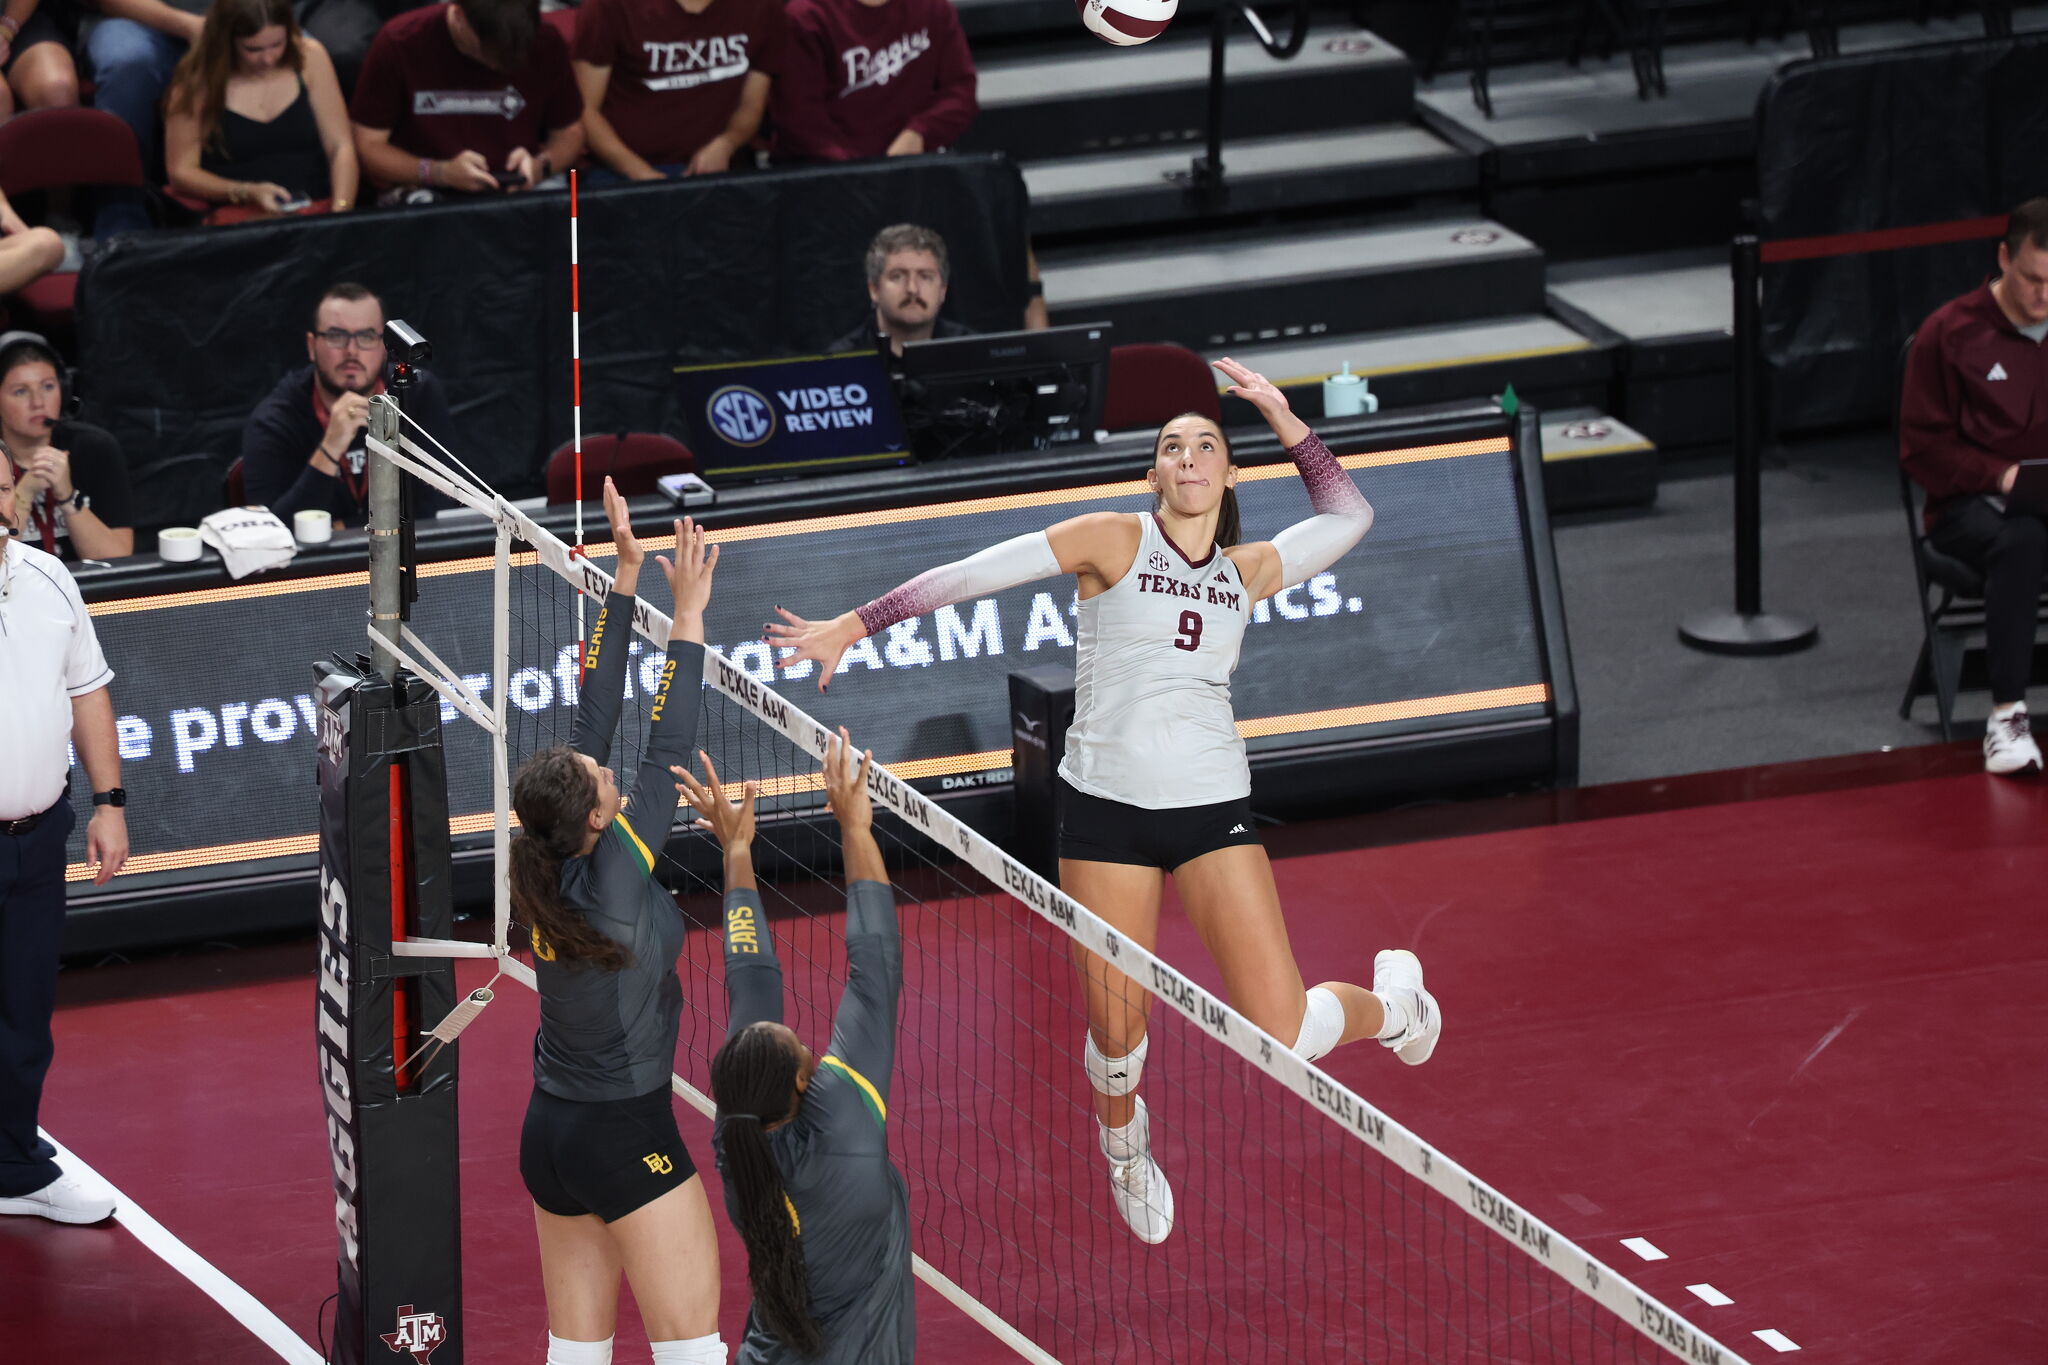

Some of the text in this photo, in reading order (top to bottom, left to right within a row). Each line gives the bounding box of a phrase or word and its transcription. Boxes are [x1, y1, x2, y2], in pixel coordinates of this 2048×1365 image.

[642, 34, 749, 72] TEXAS
[714, 391, 769, 441] SEC
[777, 384, 868, 411] VIDEO
[785, 407, 874, 432] REVIEW
[583, 565, 613, 601] TEX
[1149, 551, 1169, 571] SEC
[1138, 573, 1240, 611] TEXAS A&M
[1174, 609, 1203, 652] 9
[719, 660, 759, 708] TEXAS
[858, 758, 900, 808] EXAS
[942, 770, 1015, 790] DAKTRO
[1002, 858, 1046, 909] TEXAS
[728, 906, 759, 954] EARS
[1151, 961, 1196, 1014] TEXAS
[319, 863, 359, 1272] AGGIES
[1306, 1069, 1353, 1123] TEXAS
[642, 1152, 673, 1175] BU
[1468, 1180, 1518, 1235] TEXAS
[1635, 1296, 1687, 1353] TEXAS
